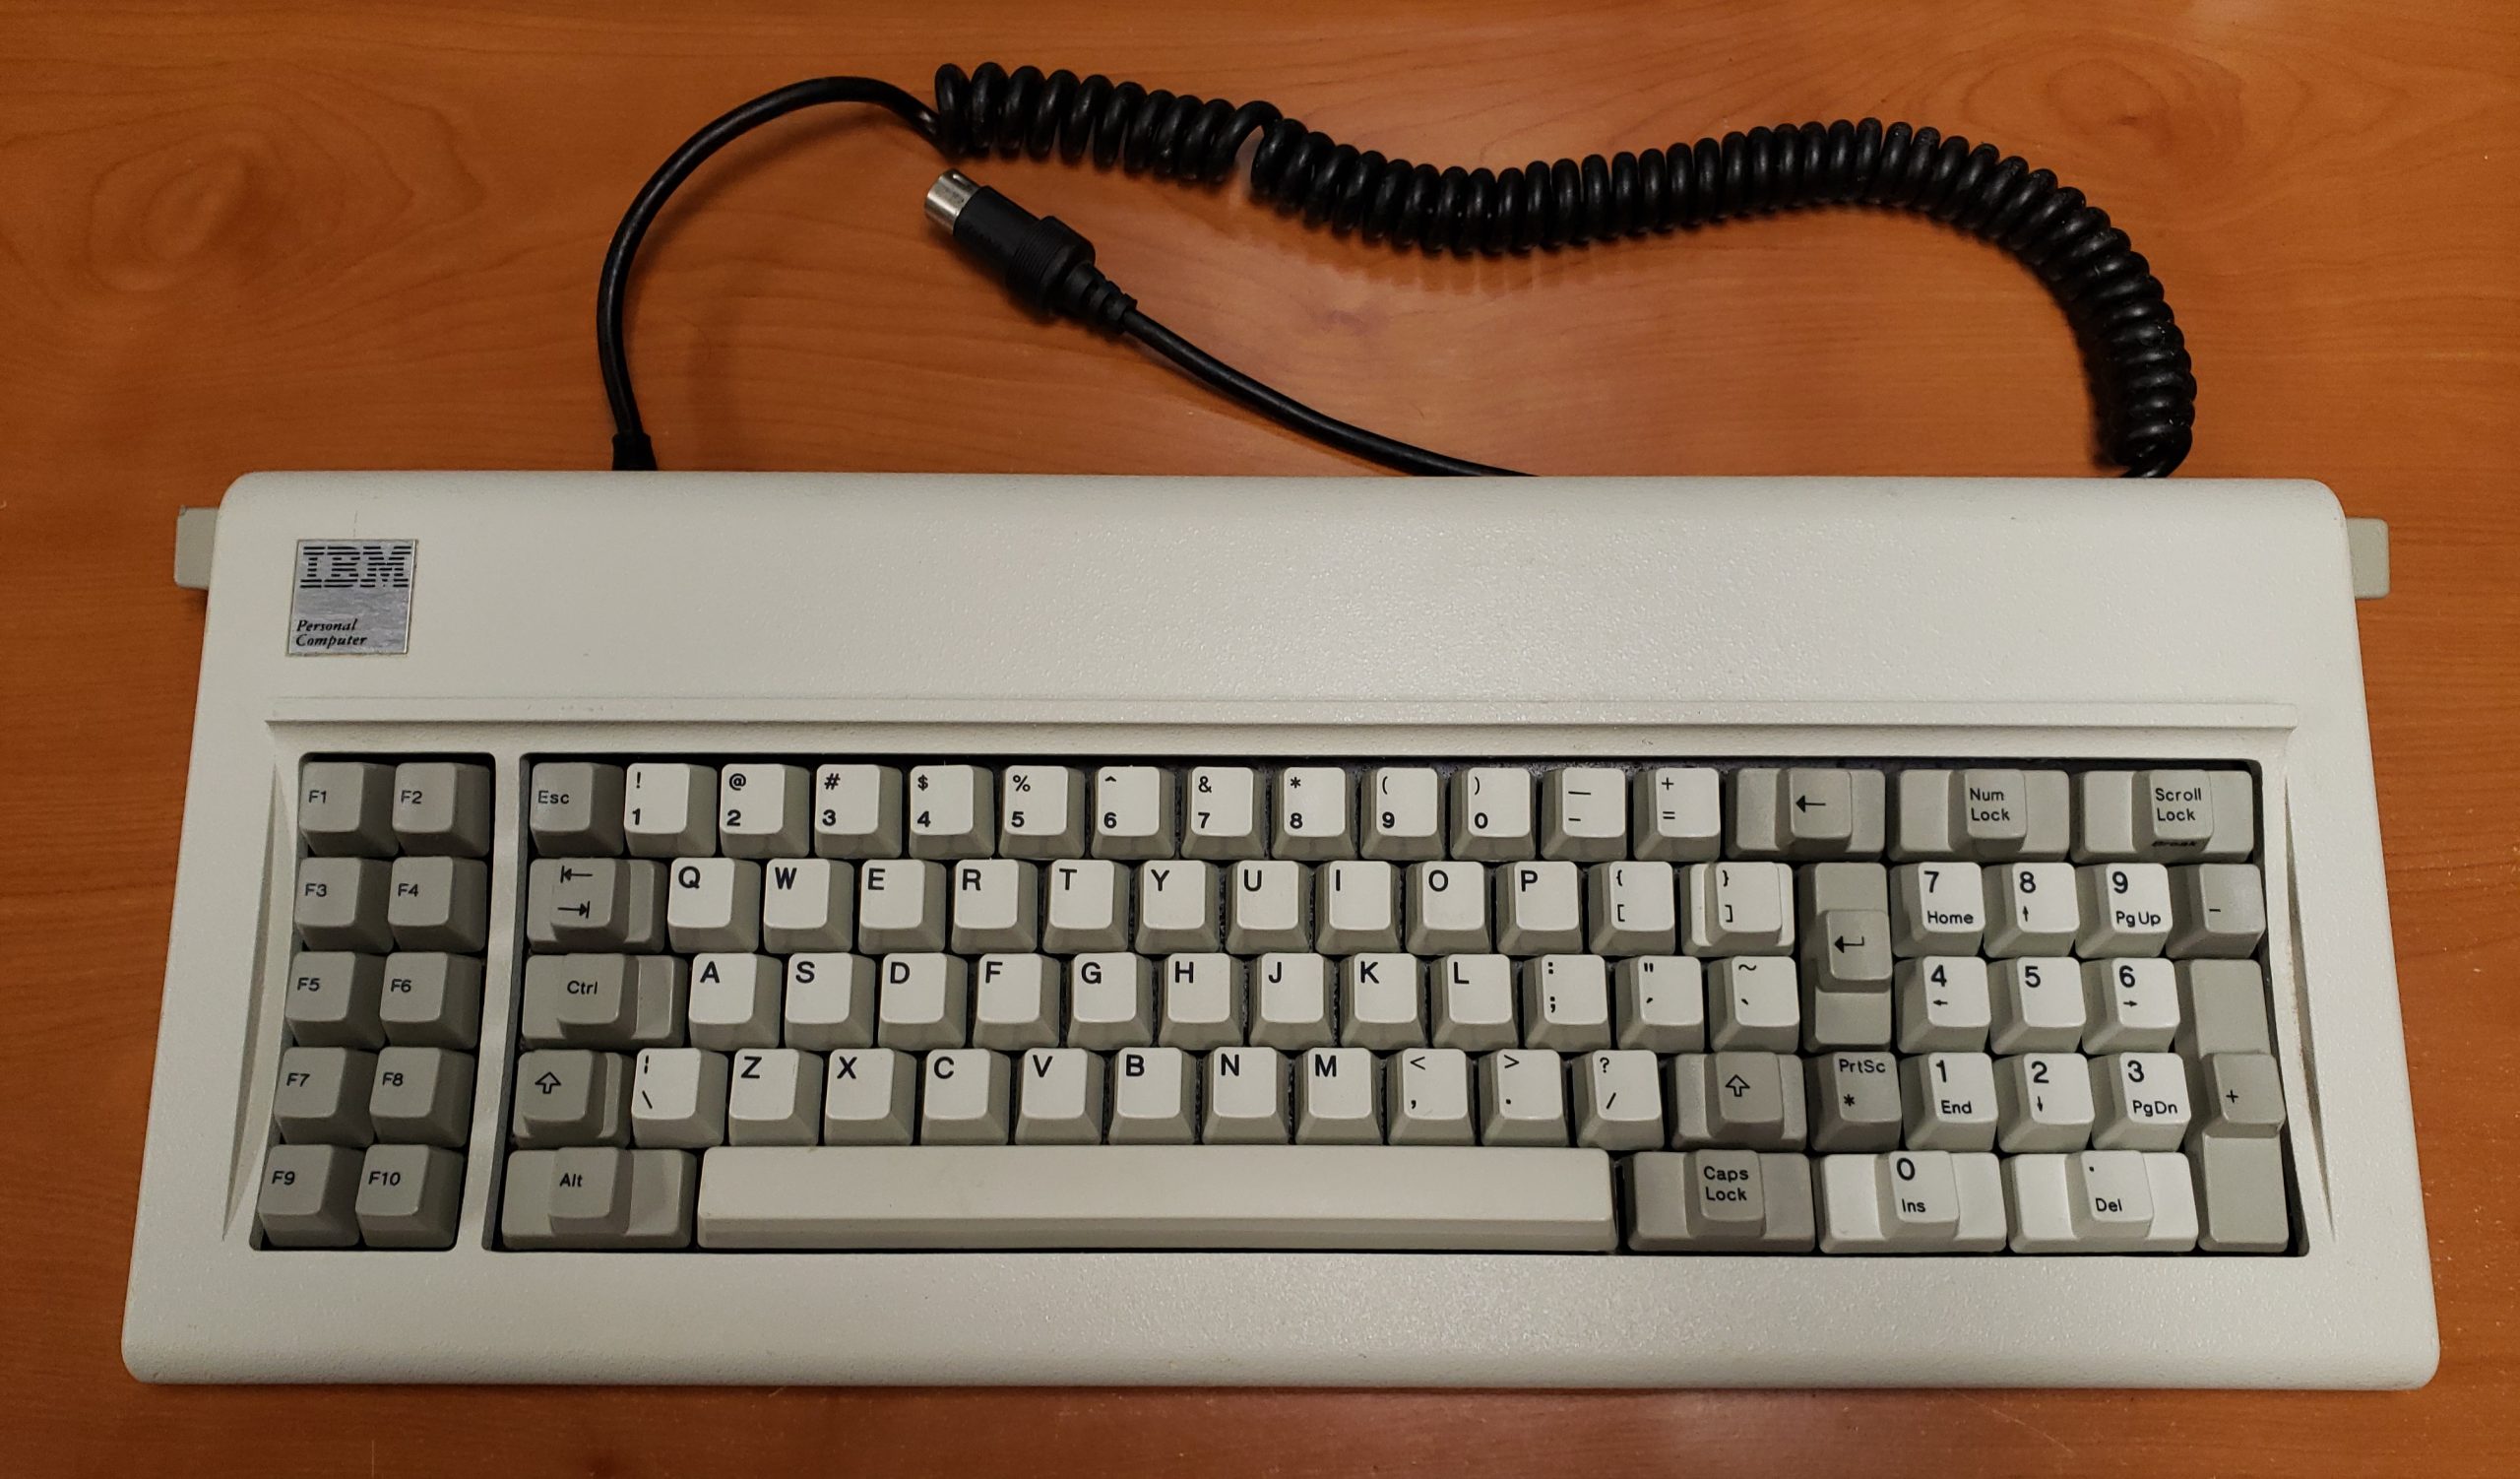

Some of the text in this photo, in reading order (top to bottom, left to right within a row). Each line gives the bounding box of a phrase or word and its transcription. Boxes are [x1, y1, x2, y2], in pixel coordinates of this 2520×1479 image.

[299, 546, 411, 589] IBM
[297, 618, 357, 631] Personal
[296, 634, 367, 649] Computer
[308, 789, 327, 804] F1
[401, 790, 423, 805] F2
[537, 790, 570, 805] Esc
[1969, 787, 2004, 802] Num
[2155, 787, 2202, 803] Scroll
[632, 807, 641, 826] 1
[726, 808, 742, 827] 2
[821, 808, 837, 827] 3
[916, 810, 931, 828] 4
[1011, 810, 1025, 828] 5
[1103, 811, 1117, 829] 6
[1197, 811, 1211, 829] 7
[1290, 811, 1303, 830] 8
[1381, 810, 1396, 829] 9
[1474, 811, 1488, 830] 0
[1970, 806, 2010, 822] Lock
[2156, 806, 2196, 822] Lock
[677, 866, 701, 889] Q
[774, 867, 797, 890] W
[867, 868, 886, 891] E
[962, 868, 981, 891] R
[1058, 868, 1078, 891] T
[1150, 868, 1170, 892] Y
[1243, 868, 1263, 892] U
[1335, 868, 1341, 892] I
[1428, 868, 1449, 893] O
[1520, 869, 1539, 893] P
[1923, 869, 1940, 894] 7
[2019, 870, 2037, 894] 8
[2111, 870, 2129, 894] 9
[304, 882, 328, 898] F3
[397, 882, 419, 898] F4
[1926, 910, 1974, 925] Home
[699, 960, 721, 984] A
[795, 960, 815, 985] S
[889, 961, 911, 985] D
[984, 960, 1004, 984] F
[1081, 961, 1102, 985] G
[1174, 960, 1194, 984] H
[1268, 961, 1283, 984] J
[1359, 960, 1380, 985] K
[1453, 961, 1470, 985] L
[1930, 964, 1948, 988] 4
[2024, 965, 2042, 989] 5
[2118, 964, 2136, 989] 6
[296, 977, 321, 993] F5
[390, 978, 412, 994] F6
[566, 980, 598, 996] Ctrl
[740, 1056, 763, 1079] Z
[836, 1056, 858, 1080] X
[933, 1056, 955, 1080] C
[1032, 1054, 1053, 1078] V
[1125, 1054, 1145, 1077] B
[1221, 1053, 1240, 1077] N
[1314, 1054, 1337, 1078] M
[1838, 1058, 1886, 1074] PrtSc
[1935, 1060, 1947, 1083] 1
[2031, 1061, 2049, 1084] 2
[2126, 1060, 2145, 1083] 3
[285, 1072, 311, 1088] F7
[382, 1071, 404, 1087] F8
[1940, 1099, 1973, 1115] End
[271, 1170, 296, 1187] F9
[367, 1170, 402, 1187] F10
[559, 1172, 583, 1188] Alt
[1703, 1165, 1749, 1184] Caps
[1896, 1157, 1916, 1182] 0
[1705, 1186, 1747, 1202] Lock
[1901, 1198, 1926, 1213] Ins
[2095, 1197, 2123, 1213] Del
